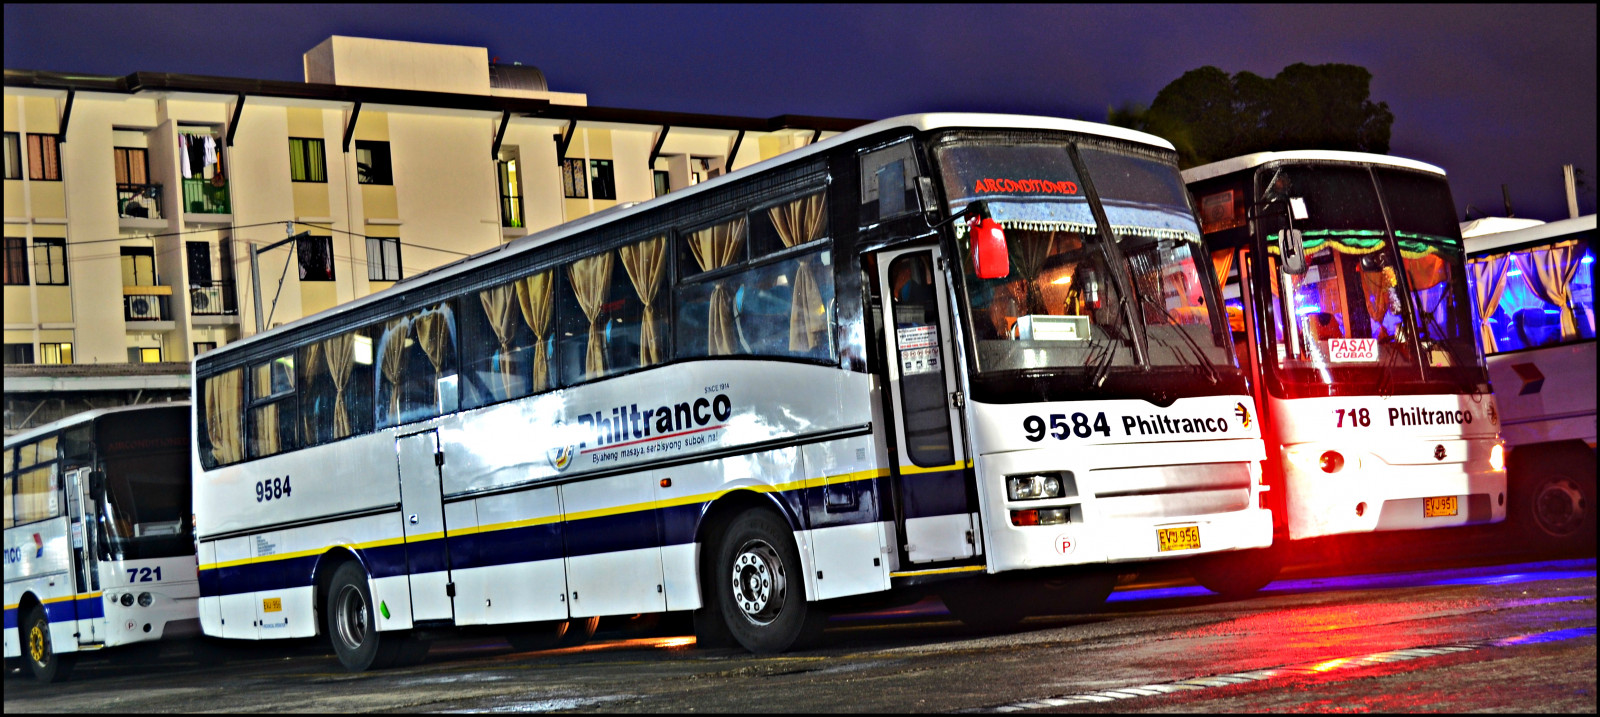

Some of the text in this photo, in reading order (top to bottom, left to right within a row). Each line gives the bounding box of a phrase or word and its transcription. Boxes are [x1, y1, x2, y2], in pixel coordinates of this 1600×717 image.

[975, 178, 1078, 194] AIRCONDITIONED
[1331, 338, 1376, 352] PASAY
[1335, 351, 1373, 359] CUBAO
[704, 382, 730, 394] SINCE 1914
[578, 393, 732, 448] Philtranco
[1335, 407, 1472, 428] 718 Philtranco
[1023, 411, 1228, 442] 9584 Philtranco
[592, 453, 618, 464] Byaheng
[684, 434, 705, 446] subok
[256, 475, 292, 503] 9584
[1426, 497, 1455, 511] EVJ 951
[1159, 528, 1198, 544] EVJ 956
[127, 566, 162, 583] 721
